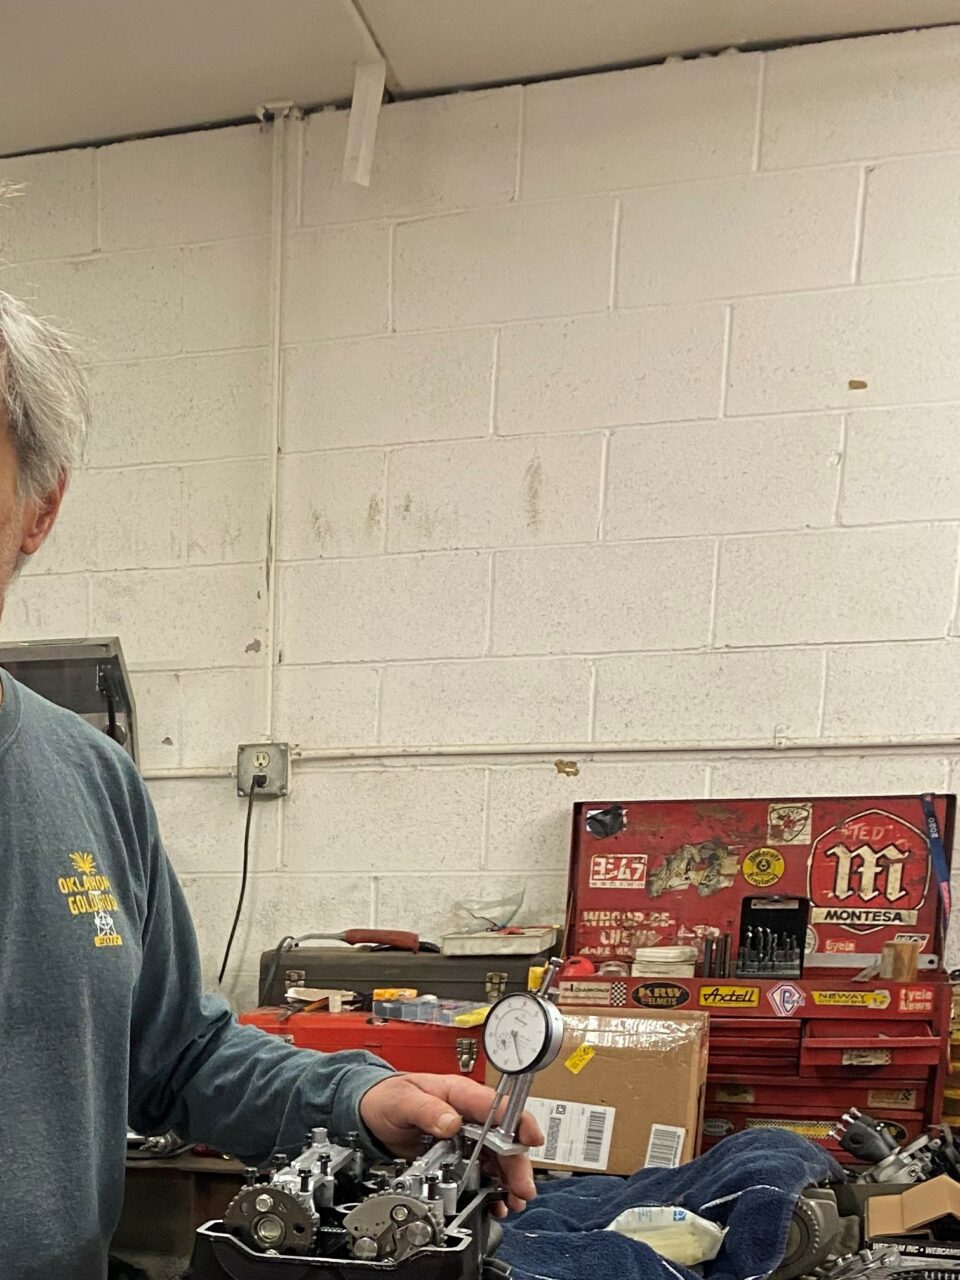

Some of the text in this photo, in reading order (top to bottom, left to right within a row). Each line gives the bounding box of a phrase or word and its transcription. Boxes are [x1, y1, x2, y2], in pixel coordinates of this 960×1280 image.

[824, 910, 904, 923] MONTESA
[99, 936, 120, 945] 2017
[703, 986, 755, 1002] Axtell
[818, 992, 867, 1000] NEWAY
[642, 997, 677, 1005] ELMETS
